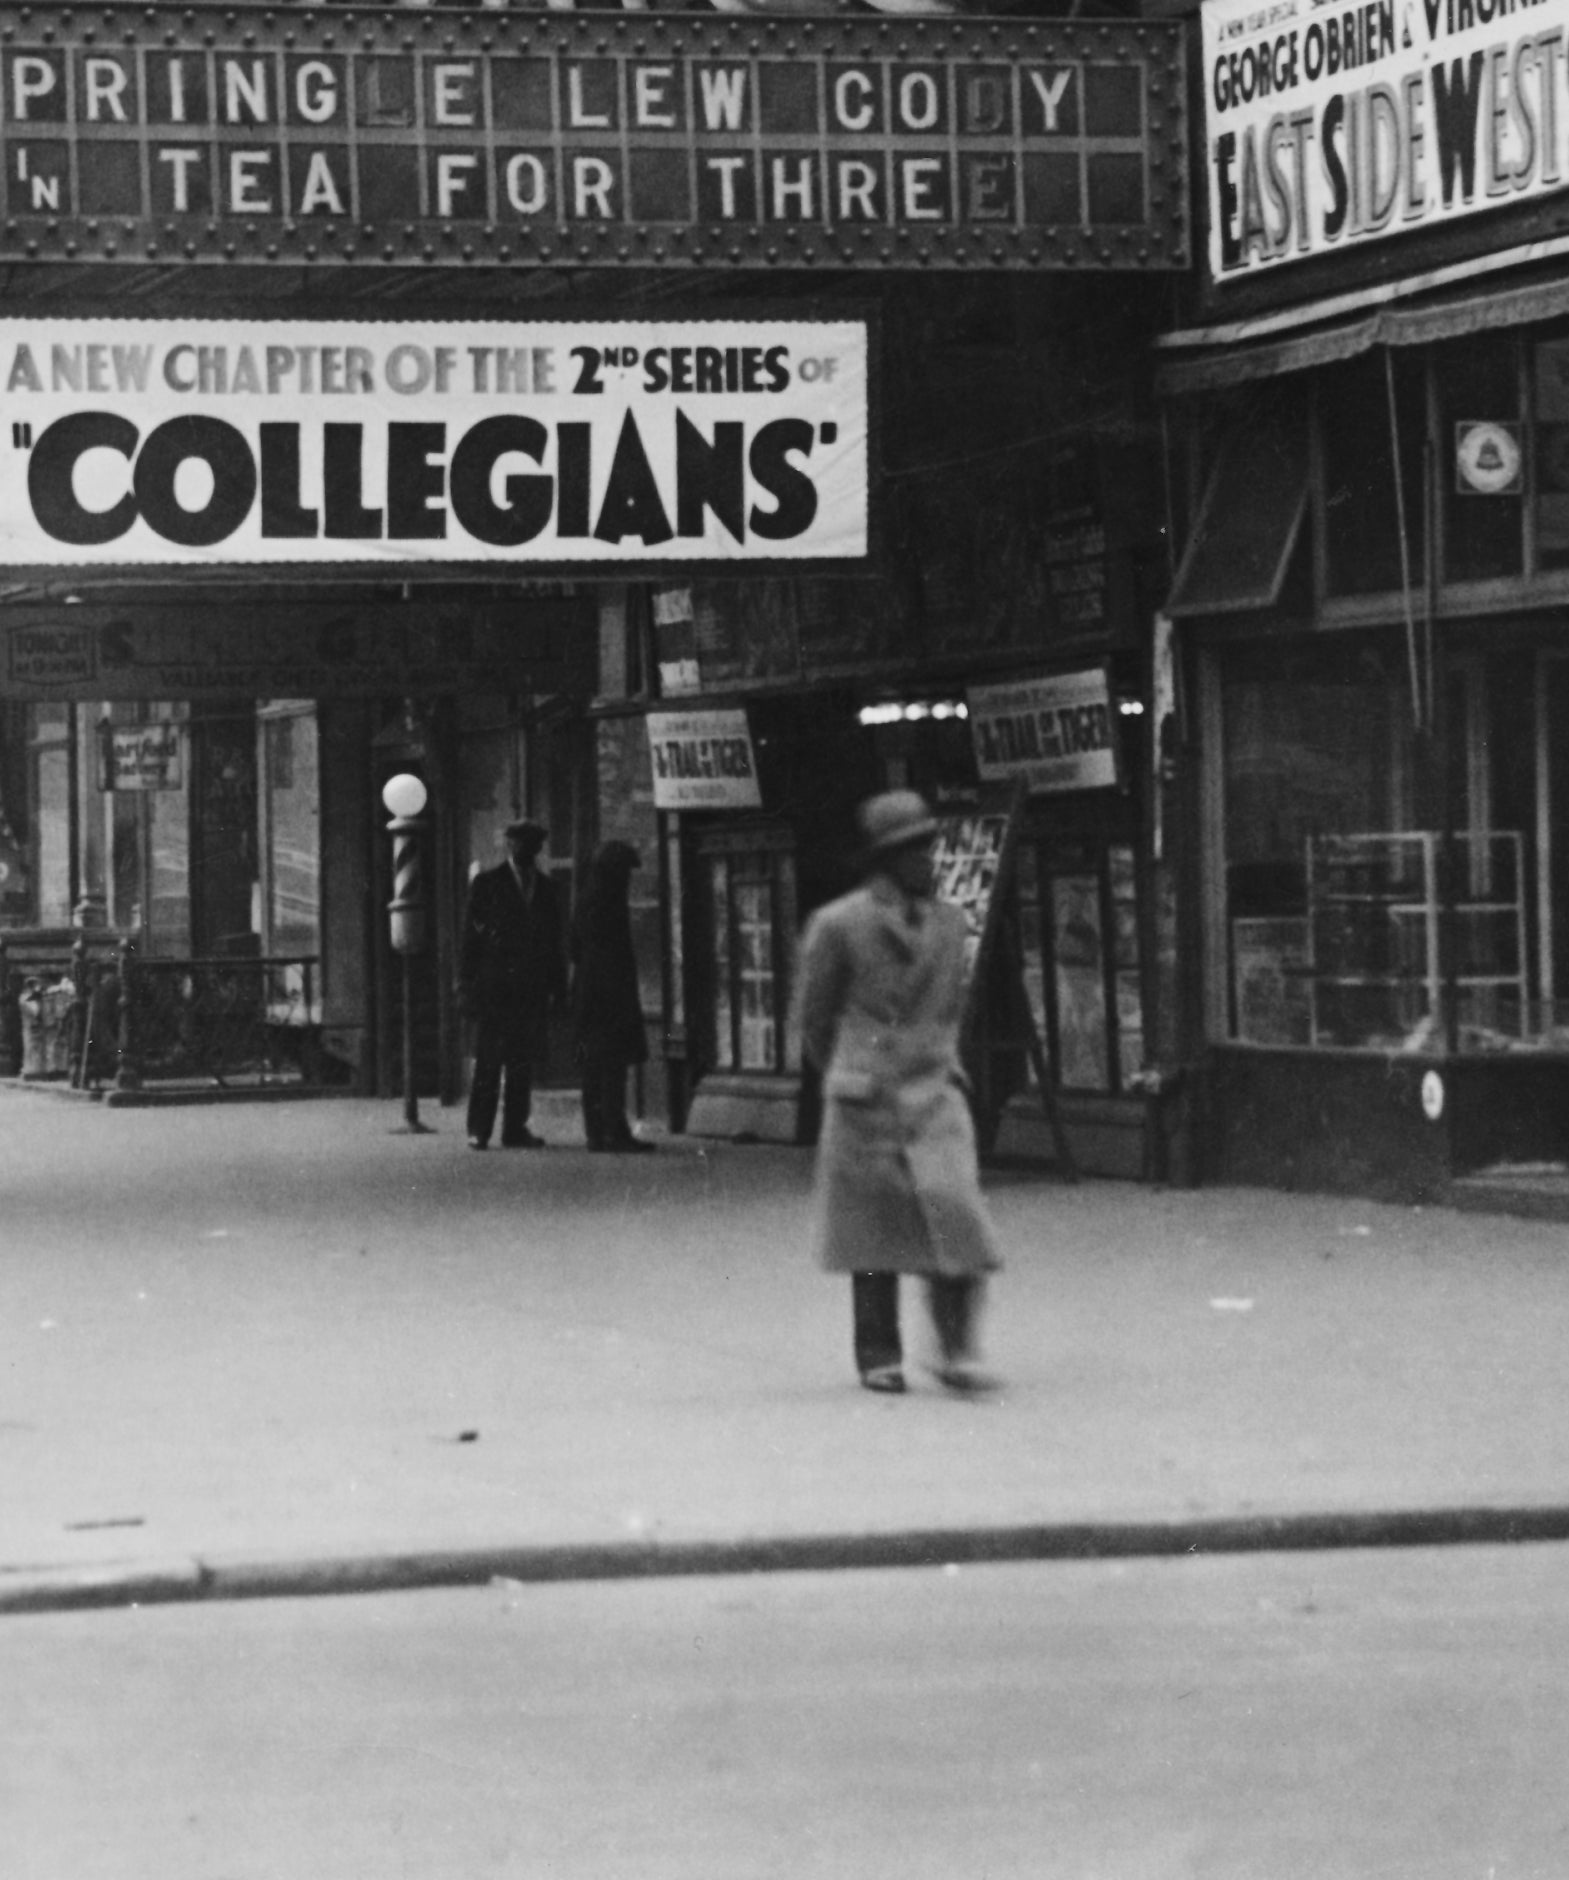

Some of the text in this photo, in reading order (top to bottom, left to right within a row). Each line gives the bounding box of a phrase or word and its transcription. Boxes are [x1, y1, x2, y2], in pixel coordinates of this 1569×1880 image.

[12, 58, 476, 125] PRINGLE
[568, 66, 748, 130] LEW
[834, 68, 1073, 132] CODY
[1213, 29, 1300, 113] GEORGE
[1430, 24, 1567, 211] WEST
[15, 147, 1010, 220] IN TEA FOR THREE
[5, 342, 45, 394] A
[50, 342, 155, 394] NEW
[162, 342, 375, 395] CHAPTER
[384, 343, 458, 395] OF
[466, 345, 558, 395] THE
[641, 345, 791, 395] SERIES
[797, 356, 840, 384] OF
